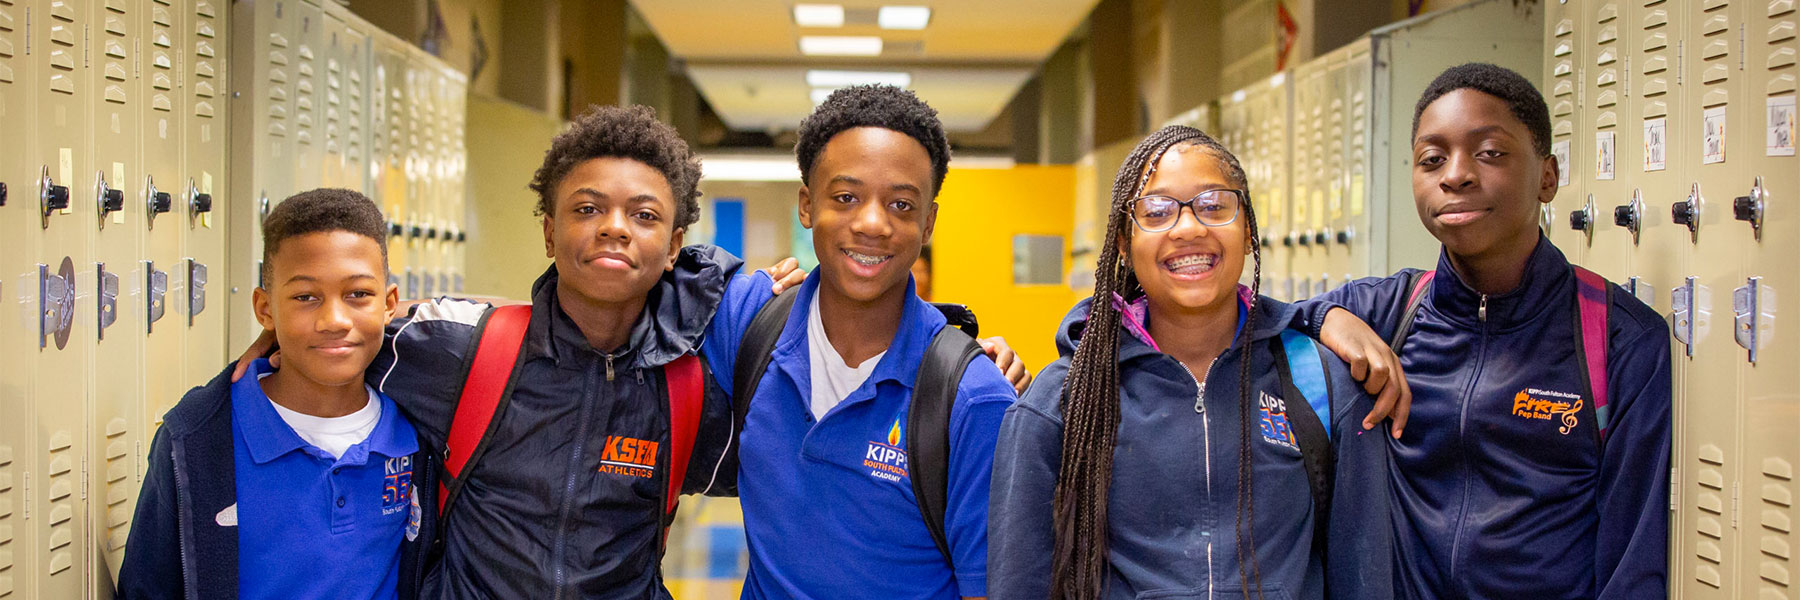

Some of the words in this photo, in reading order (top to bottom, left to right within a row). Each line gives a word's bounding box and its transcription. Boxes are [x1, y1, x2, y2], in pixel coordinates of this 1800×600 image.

[1518, 410, 1532, 419] Pep
[1533, 411, 1552, 420] Band
[600, 435, 659, 466] KSFA
[384, 456, 413, 475] KIP
[864, 459, 888, 471] SOUTH
[871, 470, 902, 483] ACADEMY
